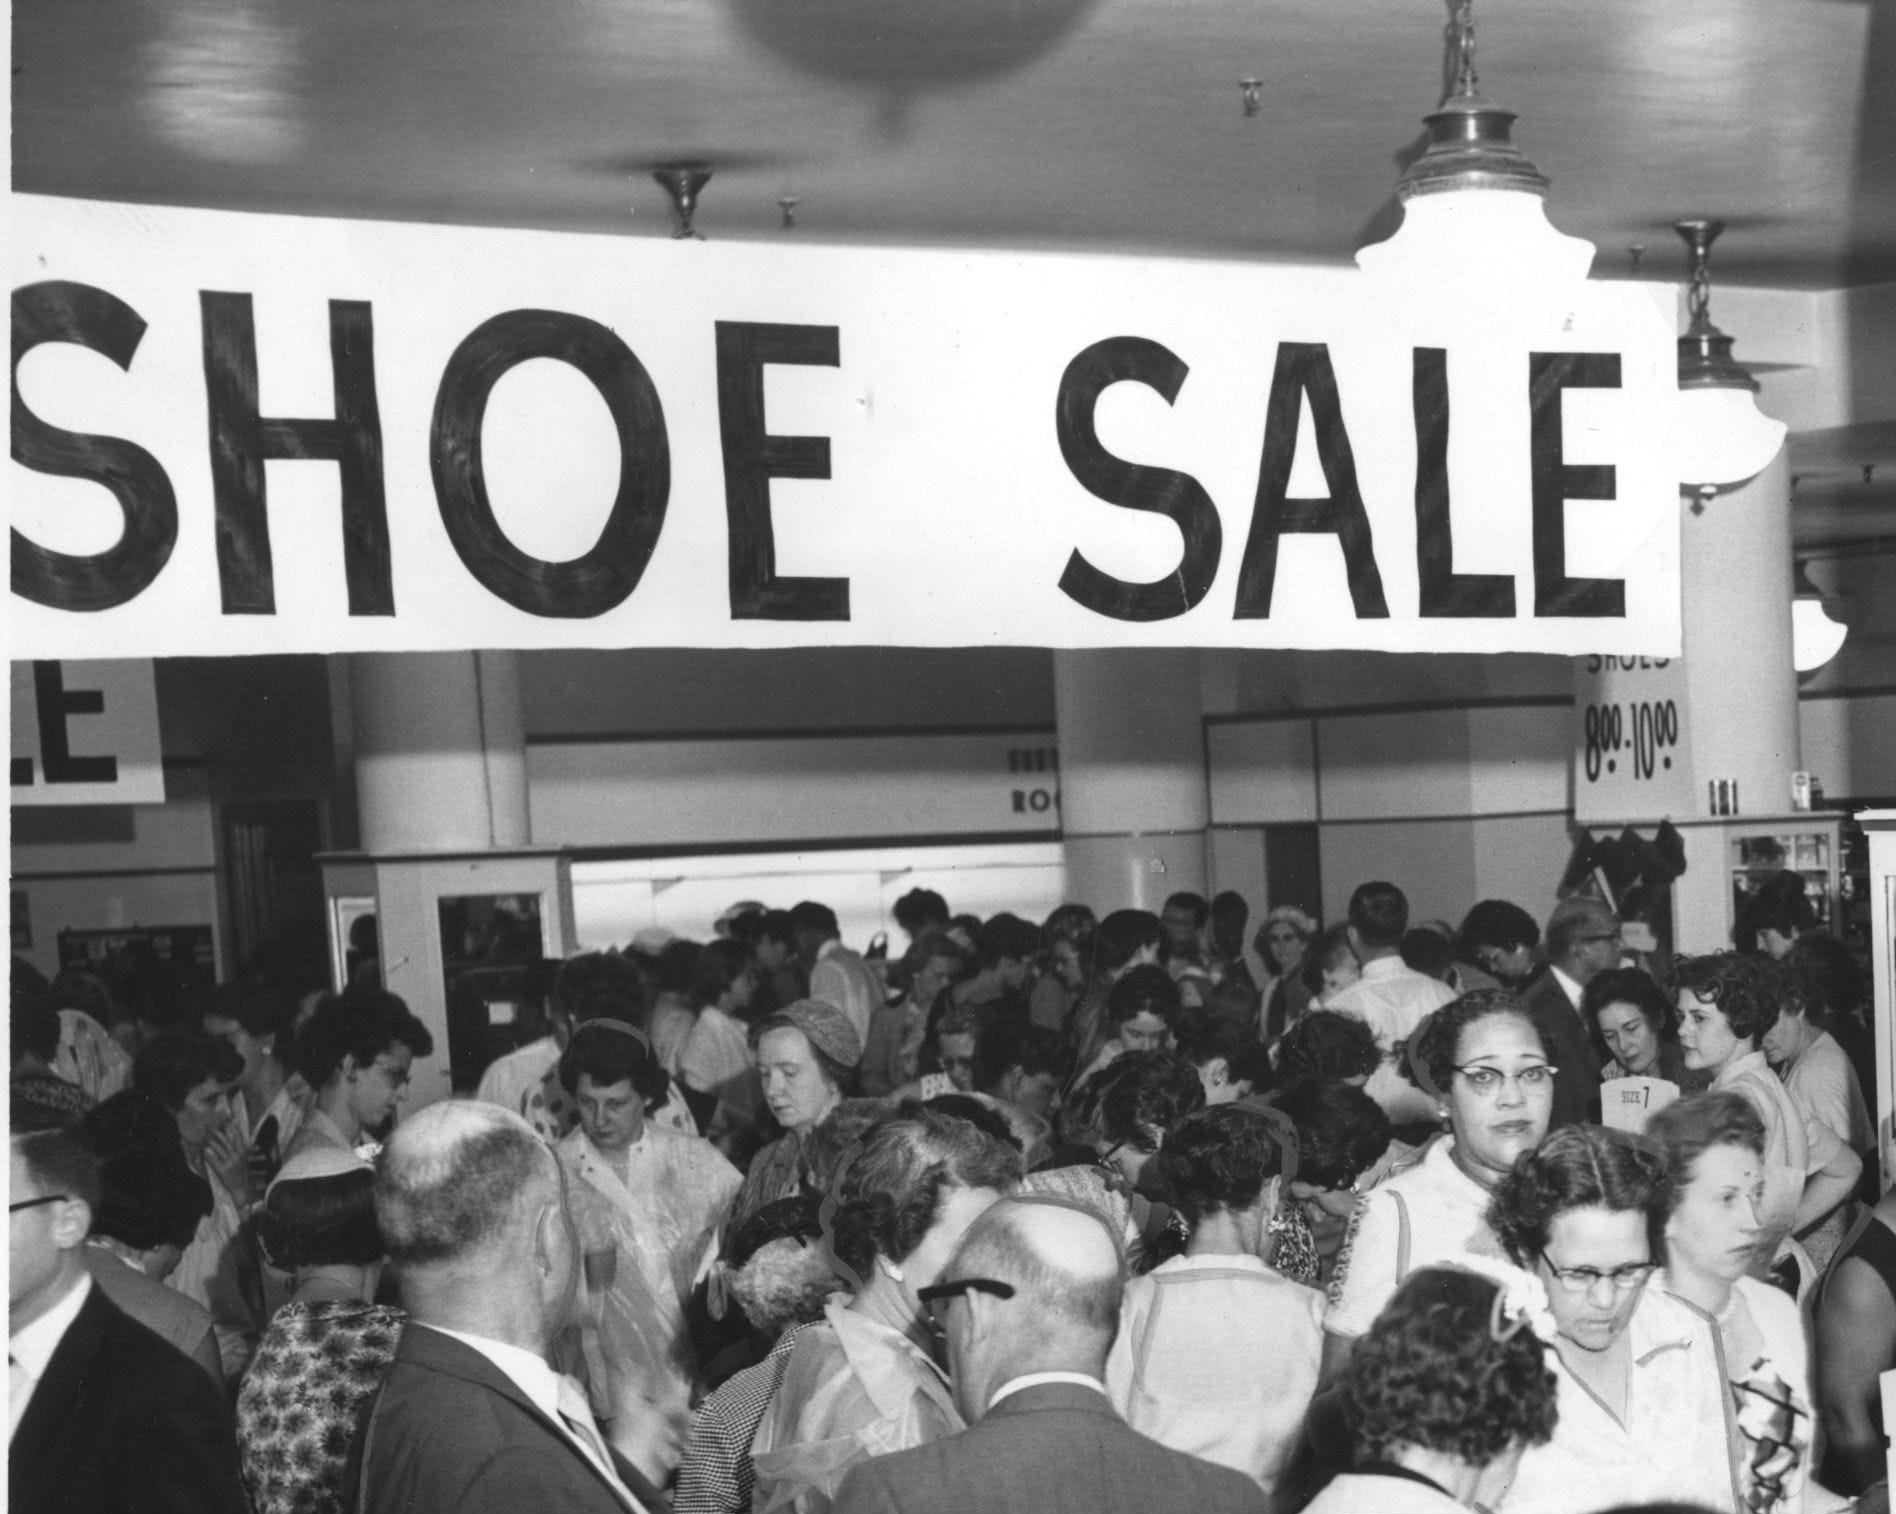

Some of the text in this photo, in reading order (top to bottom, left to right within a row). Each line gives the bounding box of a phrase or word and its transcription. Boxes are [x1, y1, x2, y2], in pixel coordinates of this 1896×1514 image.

[11, 281, 1627, 623] SHOE SALE
[11, 660, 117, 784] E
[1621, 1090, 1641, 1104] SIZE
